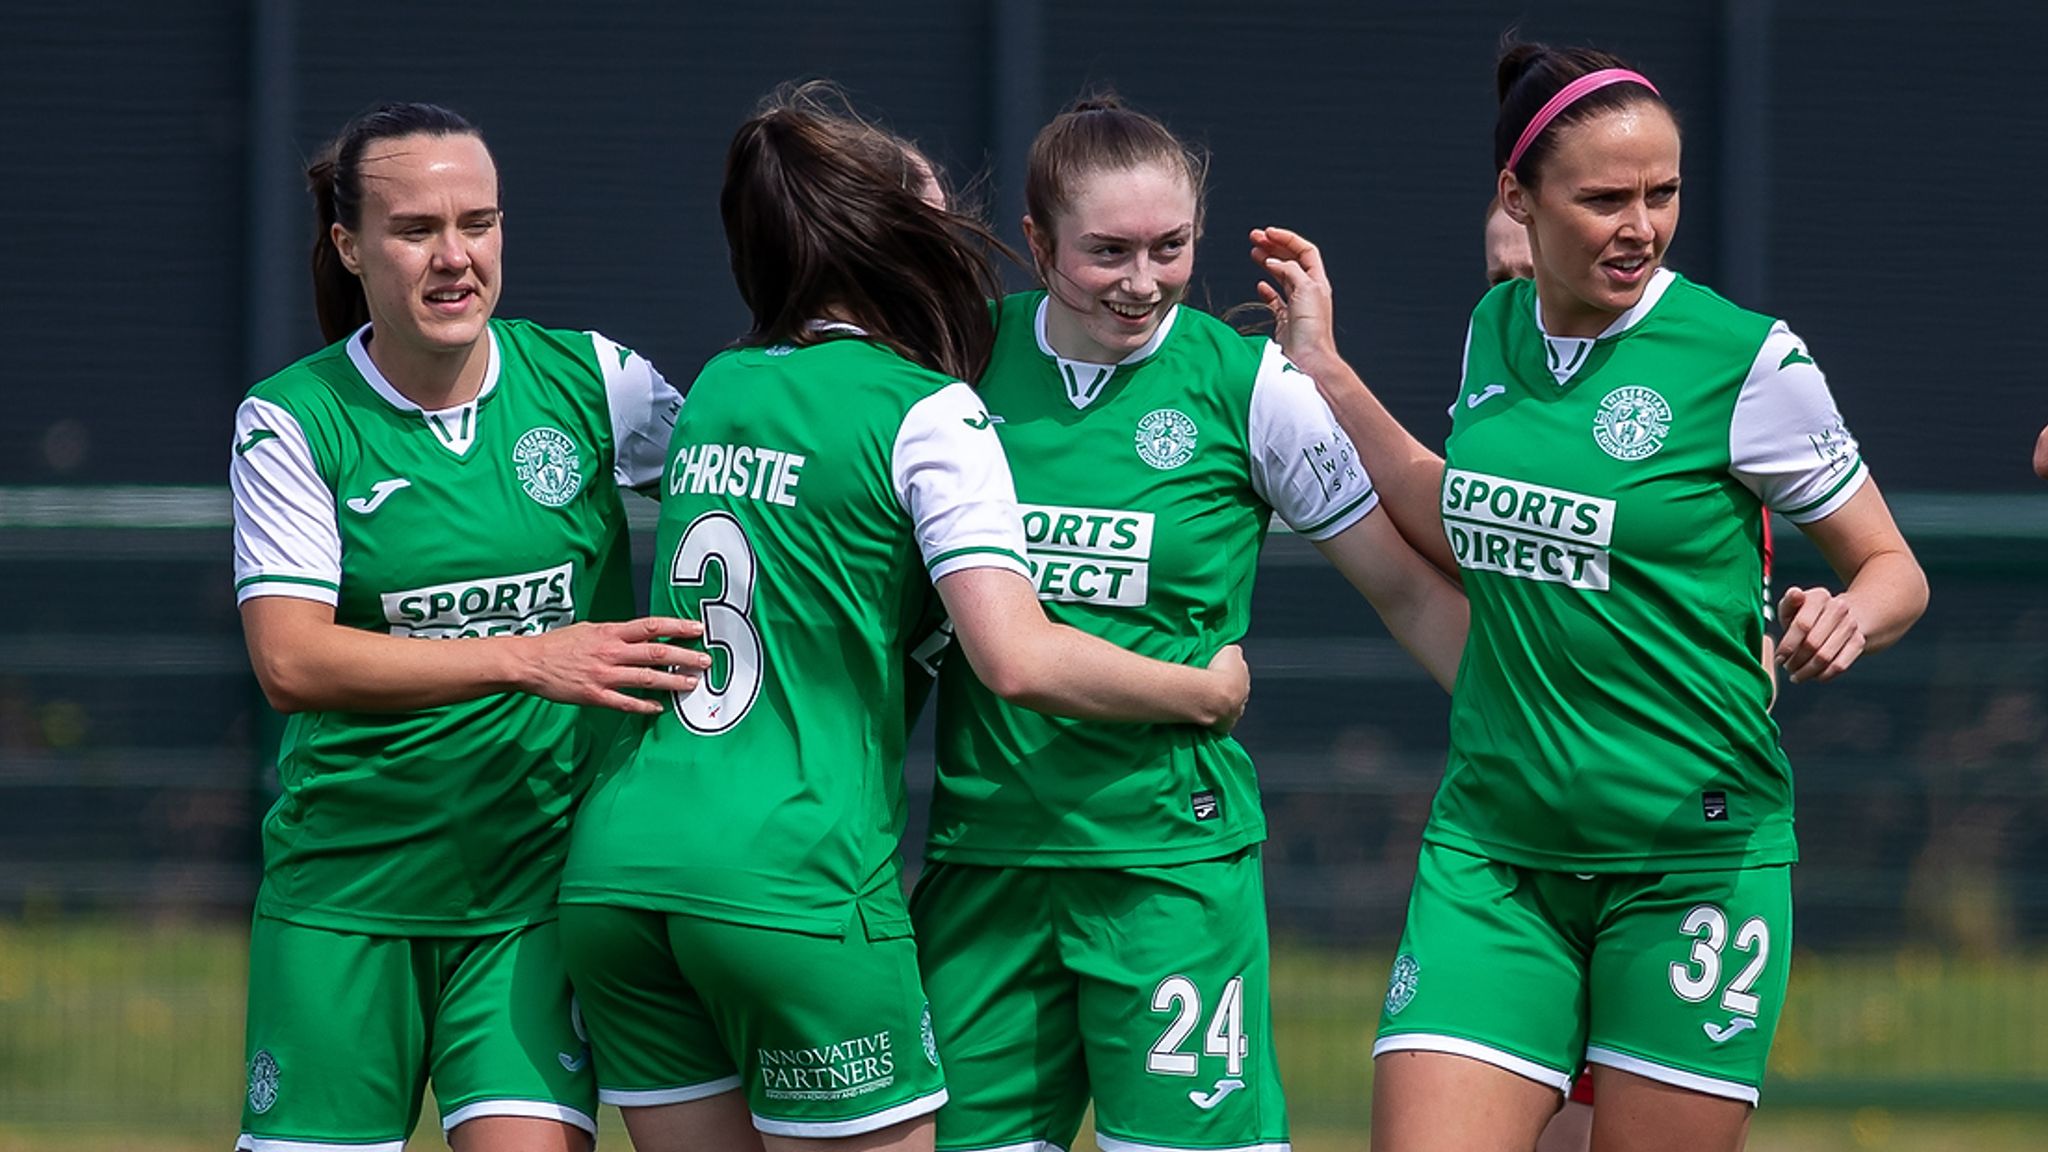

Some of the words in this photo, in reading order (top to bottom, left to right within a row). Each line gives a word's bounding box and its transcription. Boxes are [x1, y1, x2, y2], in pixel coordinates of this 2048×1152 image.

[669, 443, 806, 508] CHRISTIE
[1022, 511, 1140, 551] ORTS
[1446, 475, 1601, 537] SPORTS
[1030, 560, 1134, 600] ECT
[1452, 526, 1596, 581] DIRECT
[398, 571, 566, 623] SPORTS
[670, 509, 764, 736] 3
[1668, 904, 1769, 1017] 32
[758, 1031, 892, 1066] INNOVATIVE
[1146, 974, 1249, 1077] 24
[762, 1051, 895, 1089] PARTNERS
